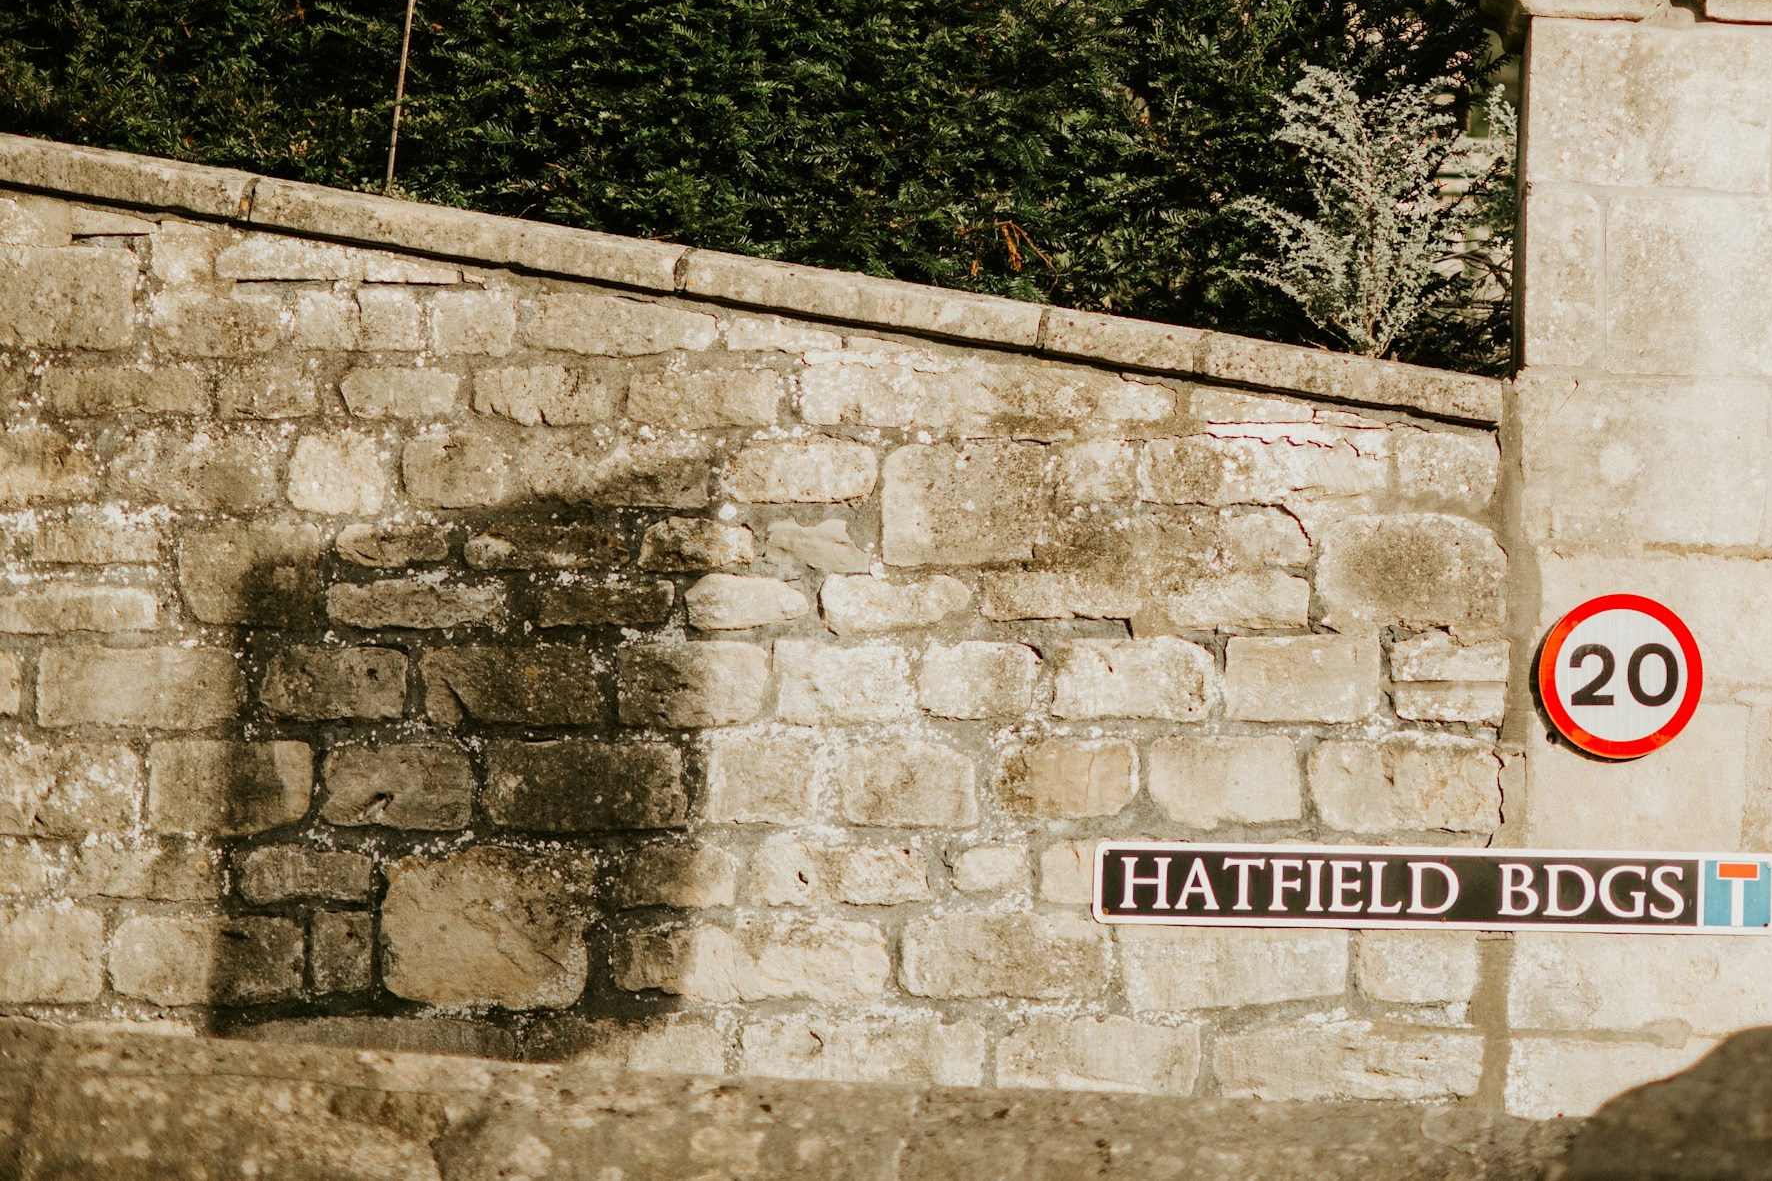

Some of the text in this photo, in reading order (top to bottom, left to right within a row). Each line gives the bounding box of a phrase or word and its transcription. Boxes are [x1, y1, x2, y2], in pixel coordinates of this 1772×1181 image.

[1569, 642, 1679, 707] 20
[1119, 856, 1686, 920] HATFIELD BDGS
